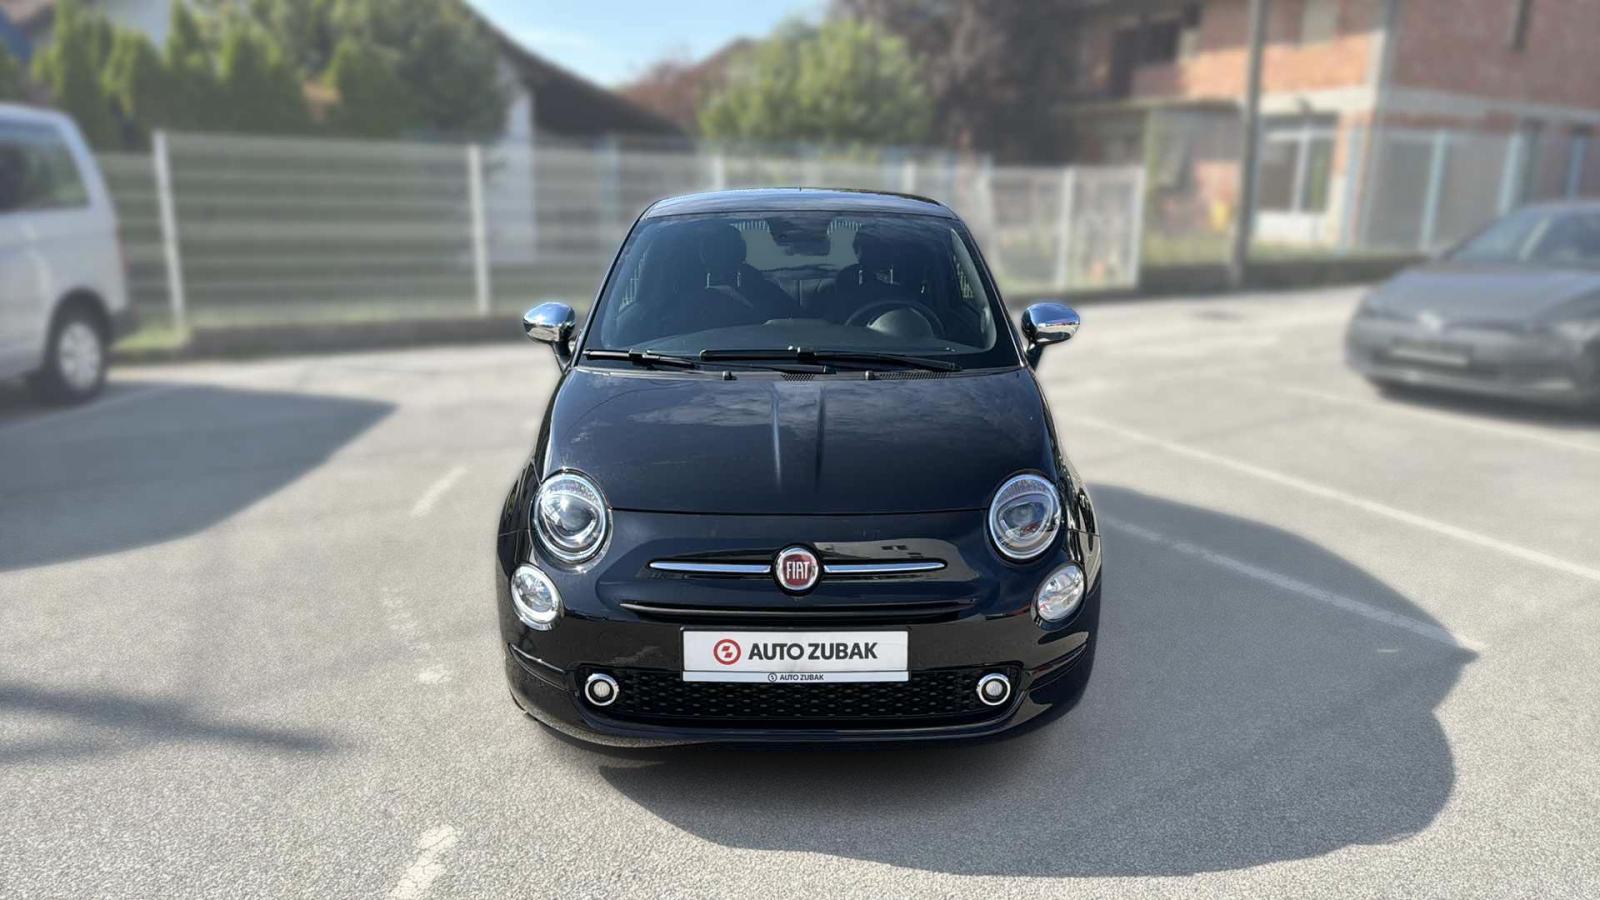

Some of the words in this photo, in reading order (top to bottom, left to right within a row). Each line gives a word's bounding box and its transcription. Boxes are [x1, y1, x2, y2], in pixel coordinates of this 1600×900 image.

[786, 561, 810, 579] FIAT
[748, 643, 805, 660] AUTO
[808, 642, 878, 660] ZUBAK
